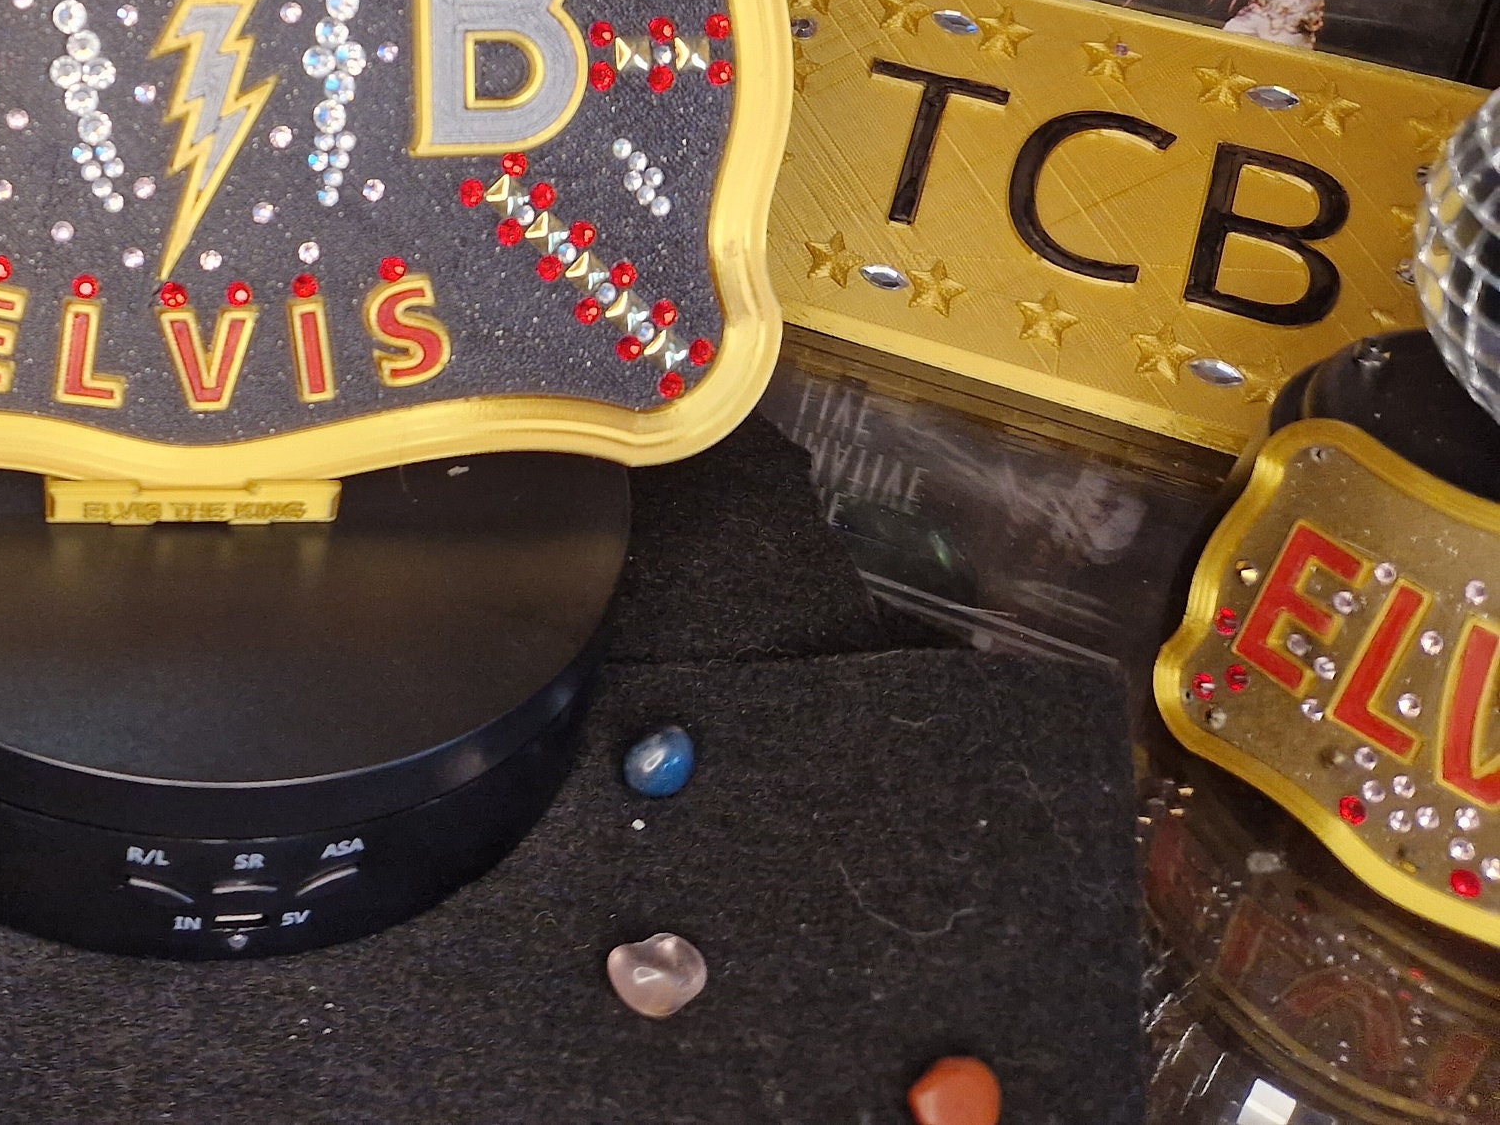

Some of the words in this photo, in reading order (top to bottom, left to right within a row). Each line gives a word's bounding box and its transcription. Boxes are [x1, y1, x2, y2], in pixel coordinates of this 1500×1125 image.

[871, 58, 1350, 328] TCB
[83, 500, 163, 521] ELVIS
[169, 501, 227, 521] THE
[234, 500, 309, 520] KING
[172, 915, 203, 932] IN
